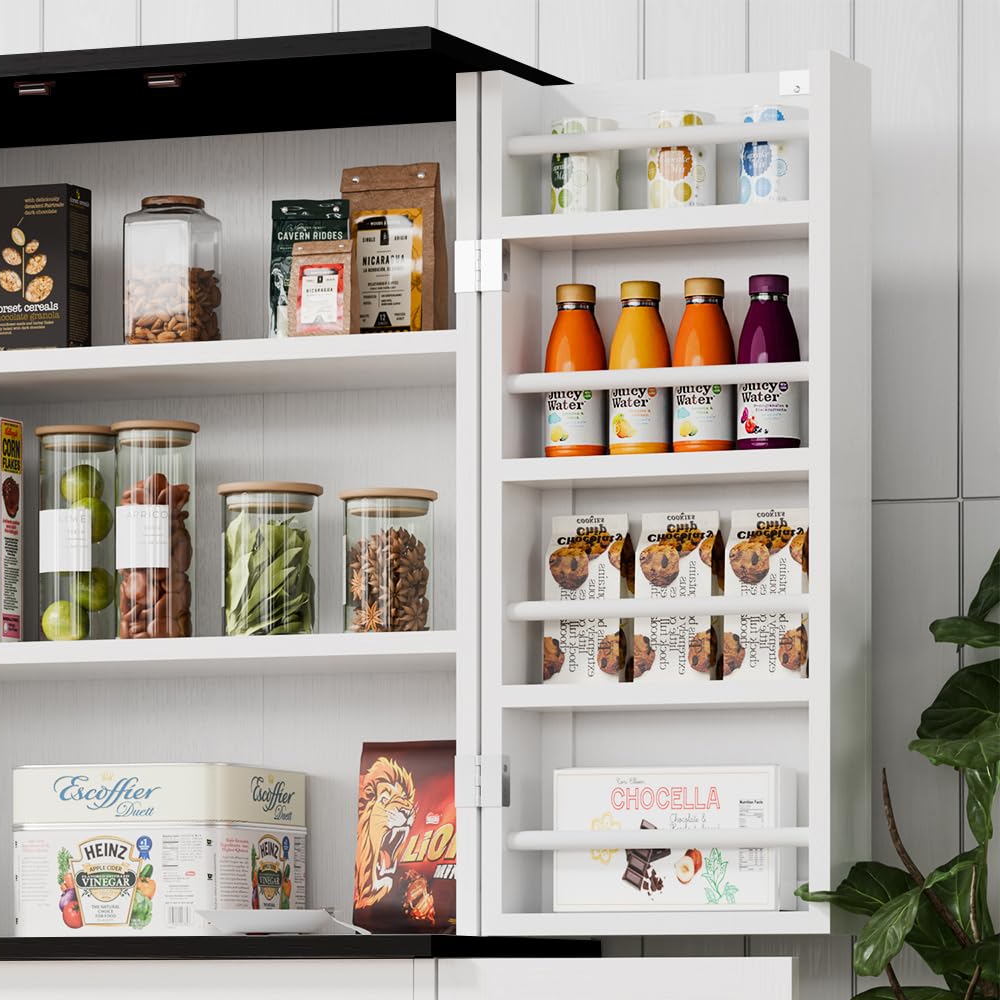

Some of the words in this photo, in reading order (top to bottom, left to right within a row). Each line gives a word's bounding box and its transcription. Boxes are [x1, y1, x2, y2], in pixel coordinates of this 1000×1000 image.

[277, 231, 310, 241] CAVERN
[313, 231, 344, 240] RIDGES
[24, 302, 58, 312] cereals
[30, 312, 60, 322] granola
[612, 397, 649, 408] Water
[676, 394, 713, 405] Water
[742, 392, 780, 402] Water
[547, 399, 584, 411] Water
[2, 438, 21, 458] CORN
[2, 457, 20, 471] FLAKES
[53, 775, 161, 811] Escoffier
[250, 776, 295, 811] Escoffier
[610, 786, 721, 811] CHOCELLA
[115, 801, 155, 817] Duett
[84, 842, 128, 861] HEINZ
[260, 841, 279, 859] HEINZ
[82, 878, 130, 887] VINEGAR
[259, 877, 280, 886] VINEGAR
